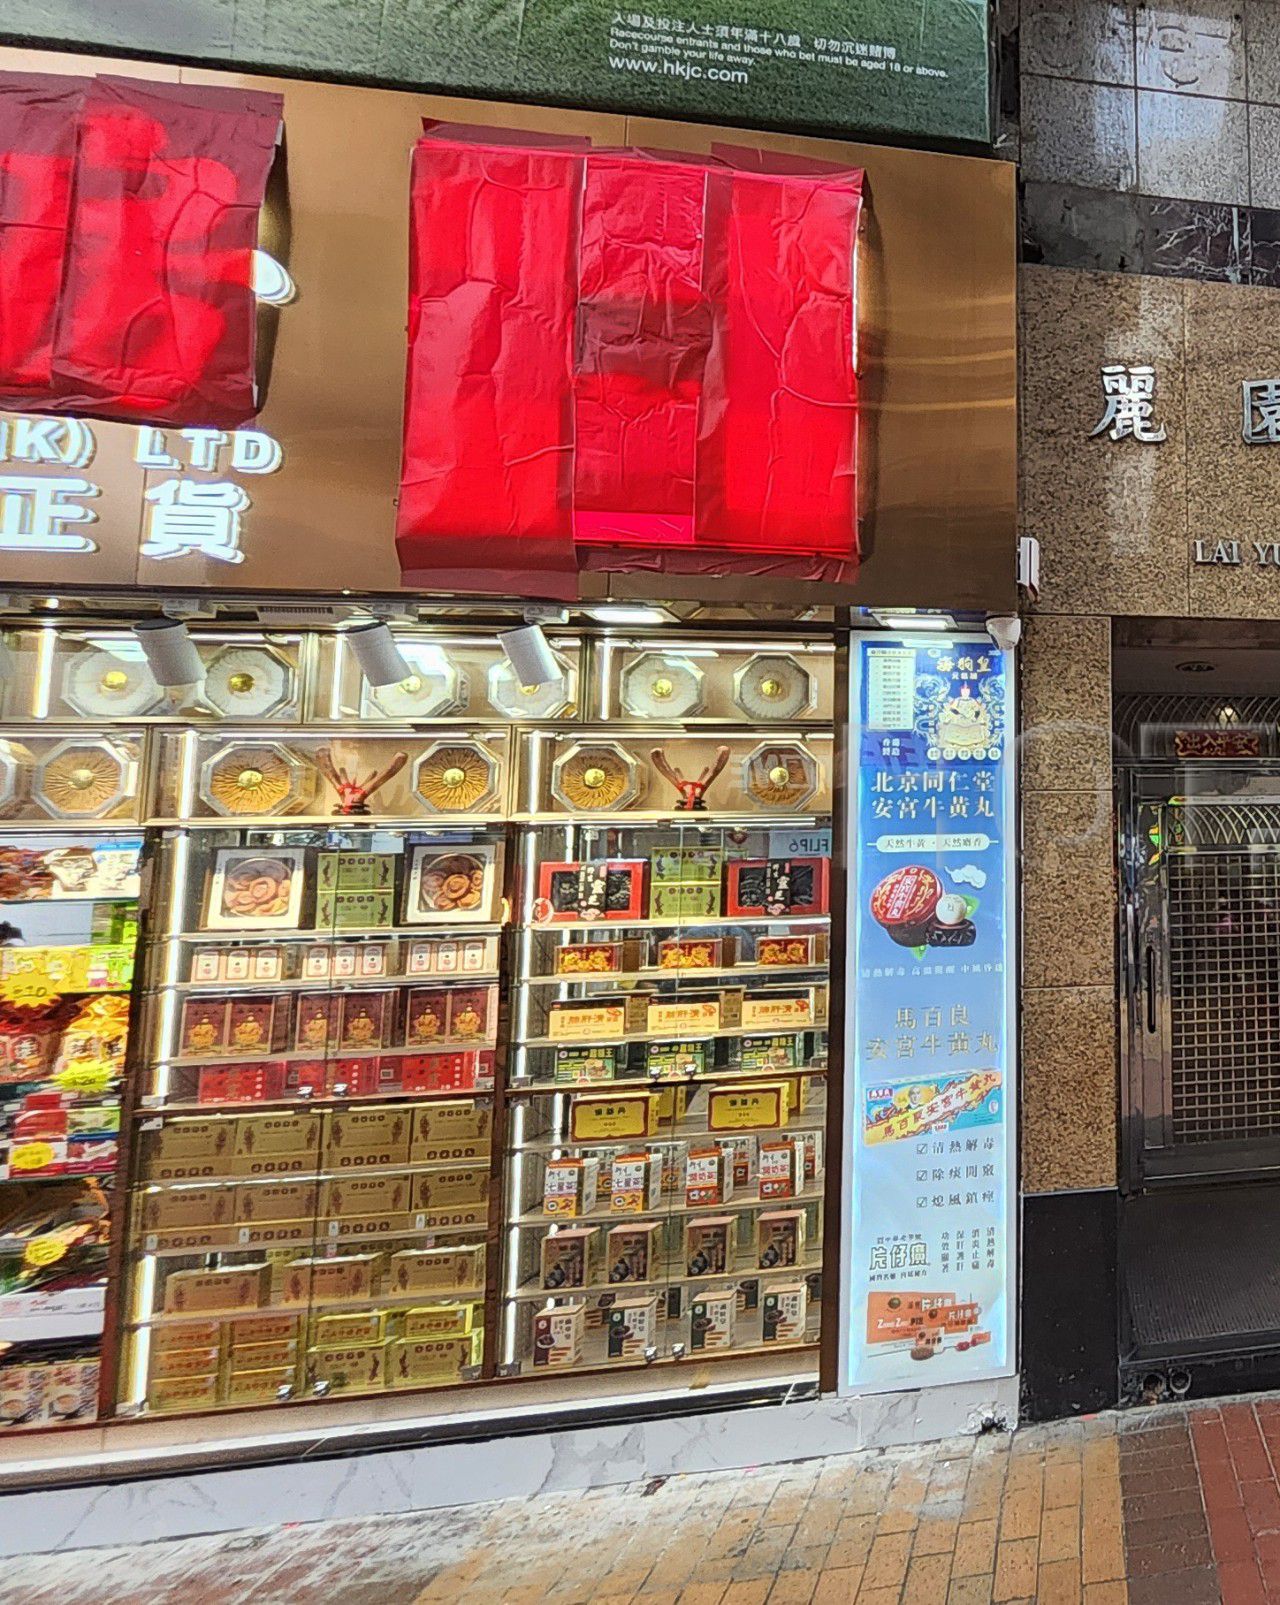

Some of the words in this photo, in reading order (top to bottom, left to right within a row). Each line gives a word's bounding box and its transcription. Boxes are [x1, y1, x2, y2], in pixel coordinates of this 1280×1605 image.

[609, 38, 638, 51] Don't
[641, 43, 681, 57] gamble
[683, 49, 707, 60] your
[709, 49, 724, 62] life
[726, 54, 756, 66] away.
[610, 28, 674, 44] Racecourse
[676, 36, 718, 49] entrants
[721, 41, 741, 52] and
[743, 43, 772, 56] those
[774, 48, 797, 59] who
[799, 50, 815, 62] bet
[817, 54, 842, 65] must
[845, 56, 858, 67] be
[861, 59, 885, 70] aged
[889, 61, 901, 72] 18
[903, 65, 914, 74] or
[916, 66, 949, 78] above.
[608, 56, 749, 85] www.hkjc.com
[0, 416, 96, 468] K)
[135, 426, 283, 475] LTD
[1194, 540, 1241, 566] LAI
[870, 770, 995, 793] 北京同仁堂
[894, 1004, 970, 1031] 馬百良
